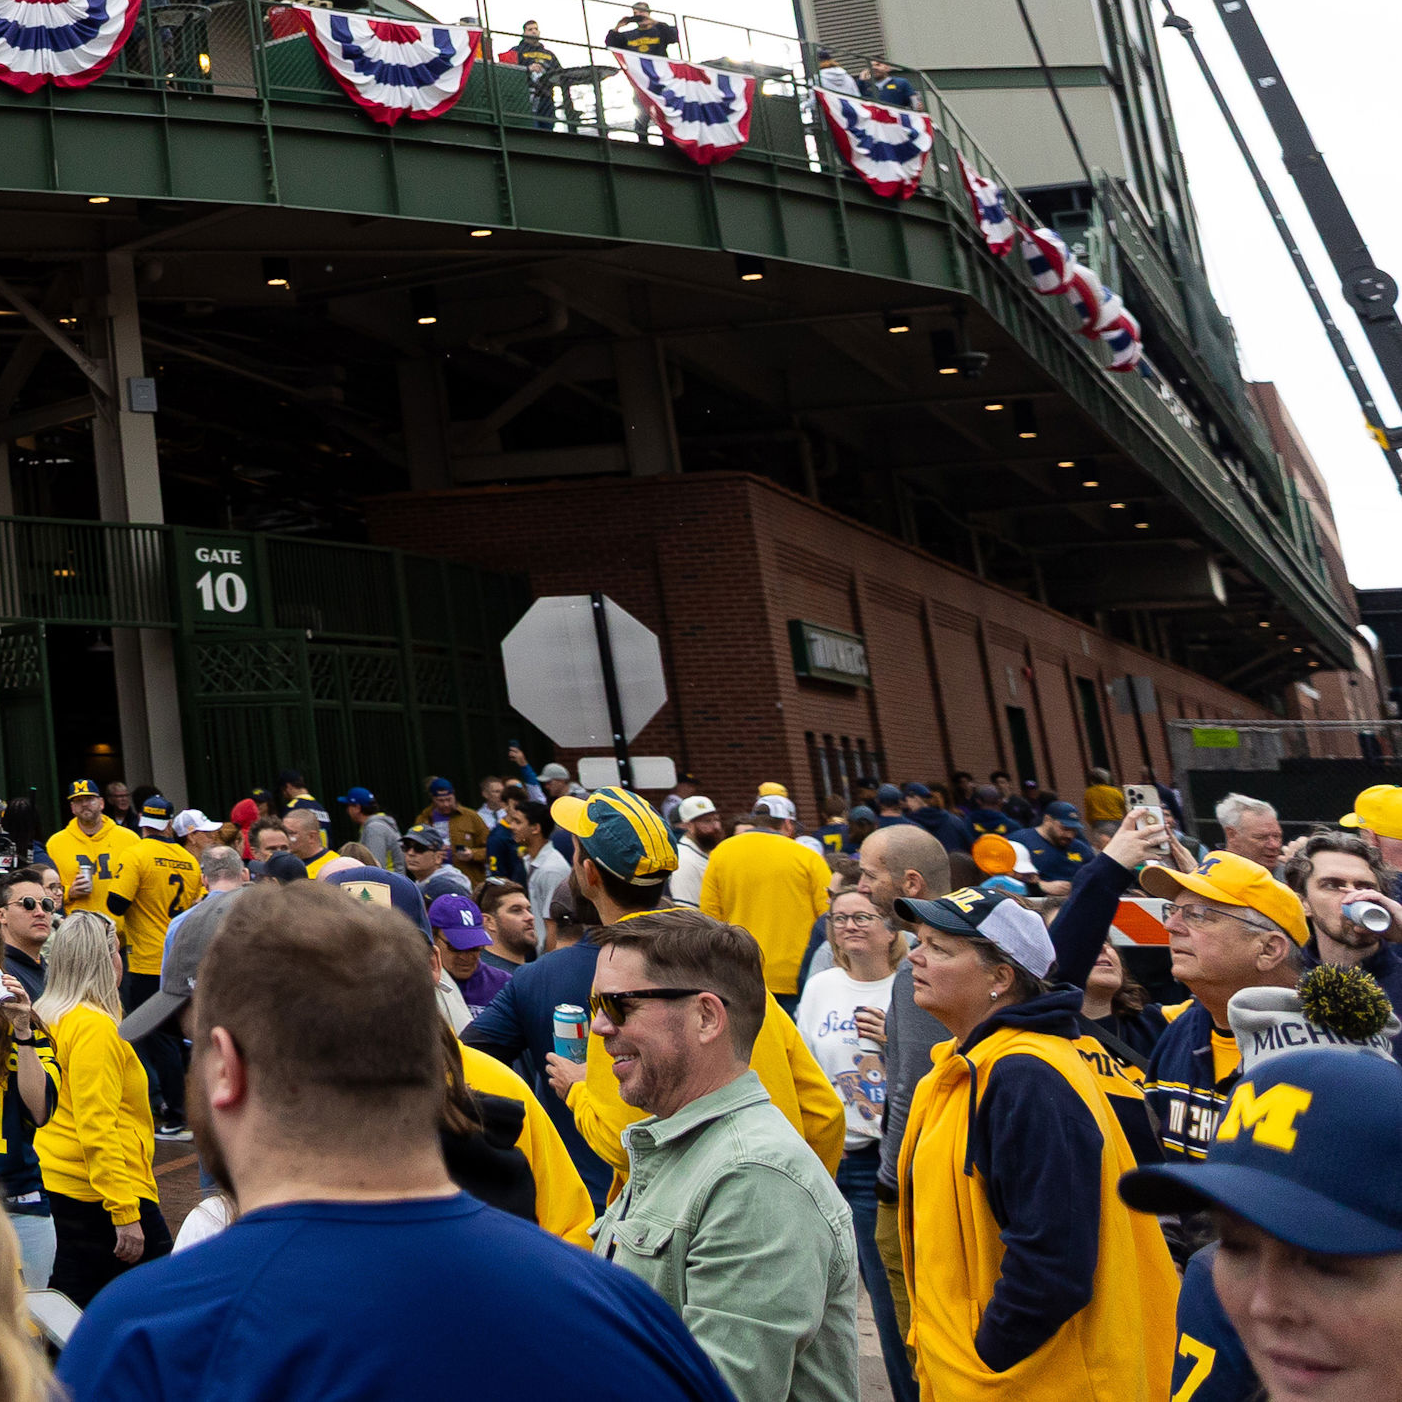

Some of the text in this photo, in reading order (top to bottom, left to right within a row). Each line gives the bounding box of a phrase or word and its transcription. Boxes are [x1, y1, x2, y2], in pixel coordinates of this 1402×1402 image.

[195, 546, 242, 565] GATE
[195, 571, 248, 614] 10
[73, 779, 89, 793] M
[76, 853, 113, 880] M
[168, 873, 185, 919] 2
[460, 909, 475, 927] N
[1216, 1080, 1314, 1154] M
[1172, 1332, 1216, 1402] 7
